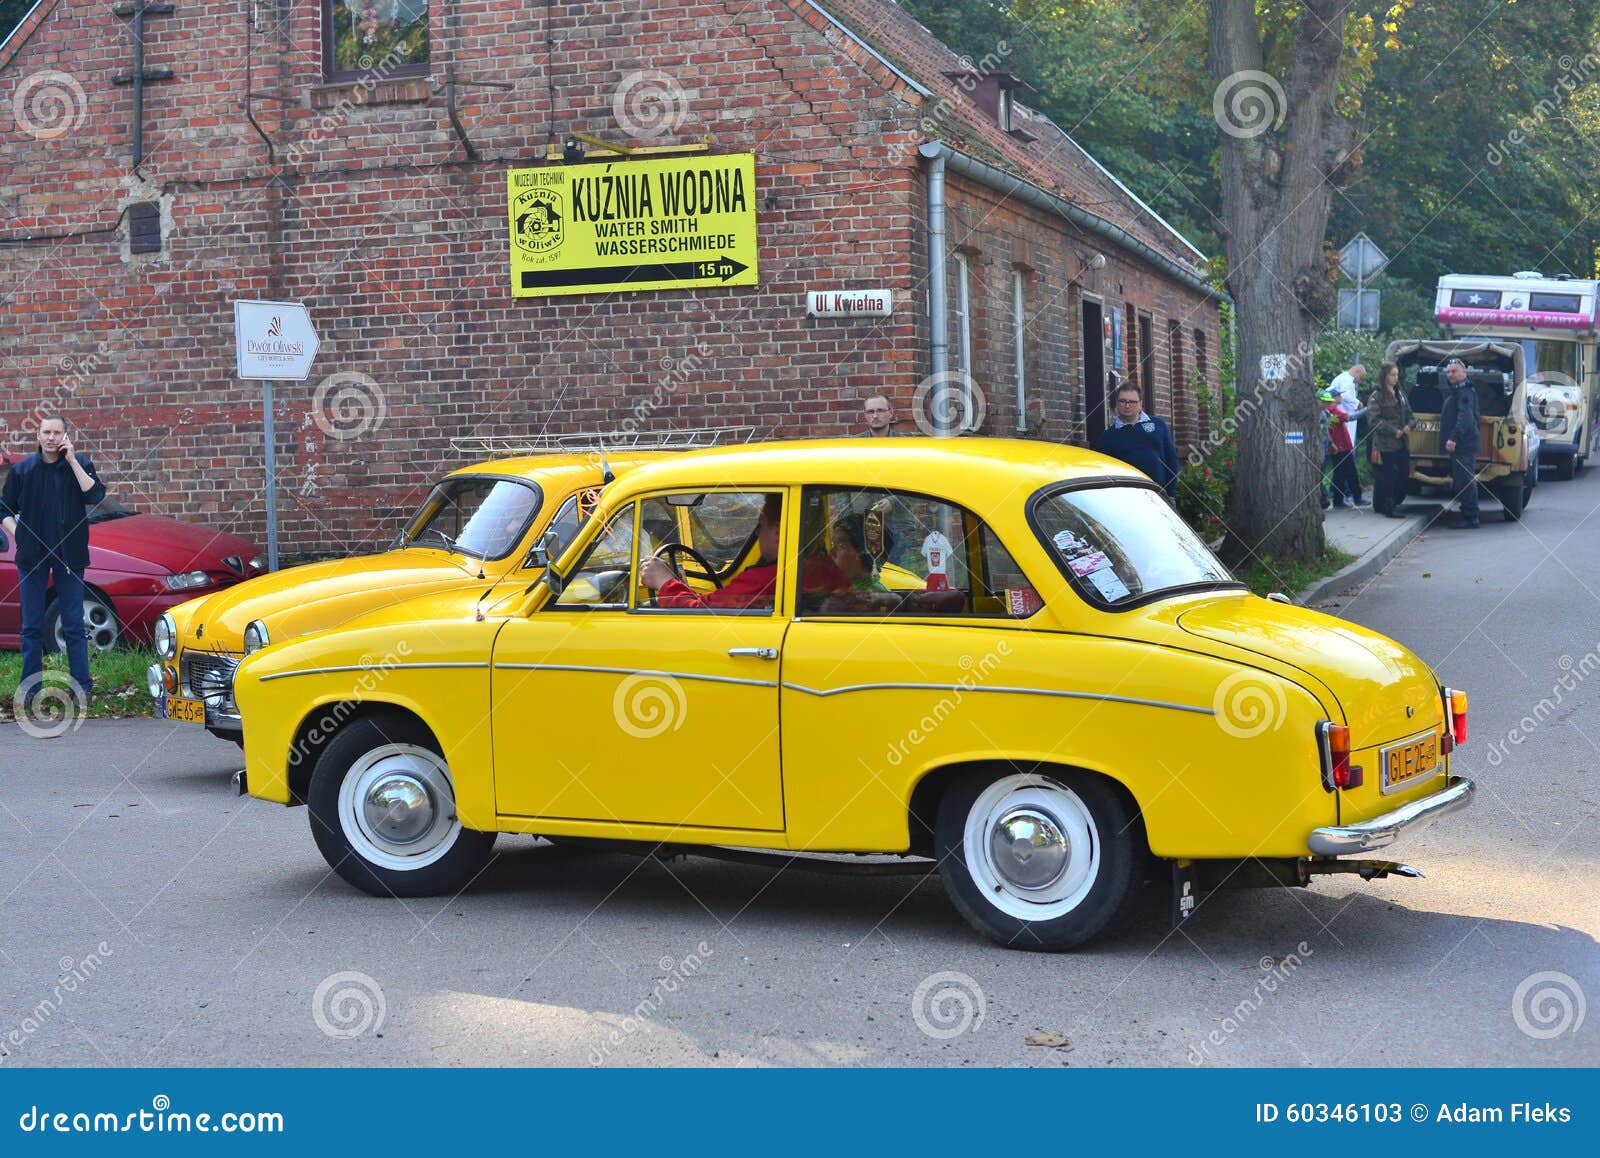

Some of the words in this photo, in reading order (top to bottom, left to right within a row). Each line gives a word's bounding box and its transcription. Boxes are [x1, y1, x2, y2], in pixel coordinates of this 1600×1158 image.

[514, 173, 538, 187] MUZEUM
[540, 171, 564, 185] TECHNIKI
[572, 164, 653, 222] KUŹNIA
[660, 168, 746, 216] WODNA
[595, 222, 645, 238] WATER
[651, 218, 698, 235] SMITH
[528, 234, 561, 250] Oliwie
[595, 234, 736, 256] WASSERSCHMIEDE
[699, 263, 715, 276] 15
[720, 264, 733, 275] m
[816, 294, 830, 312] Ul.
[834, 294, 883, 312] Kwietna
[1390, 746, 1412, 782] GLE
